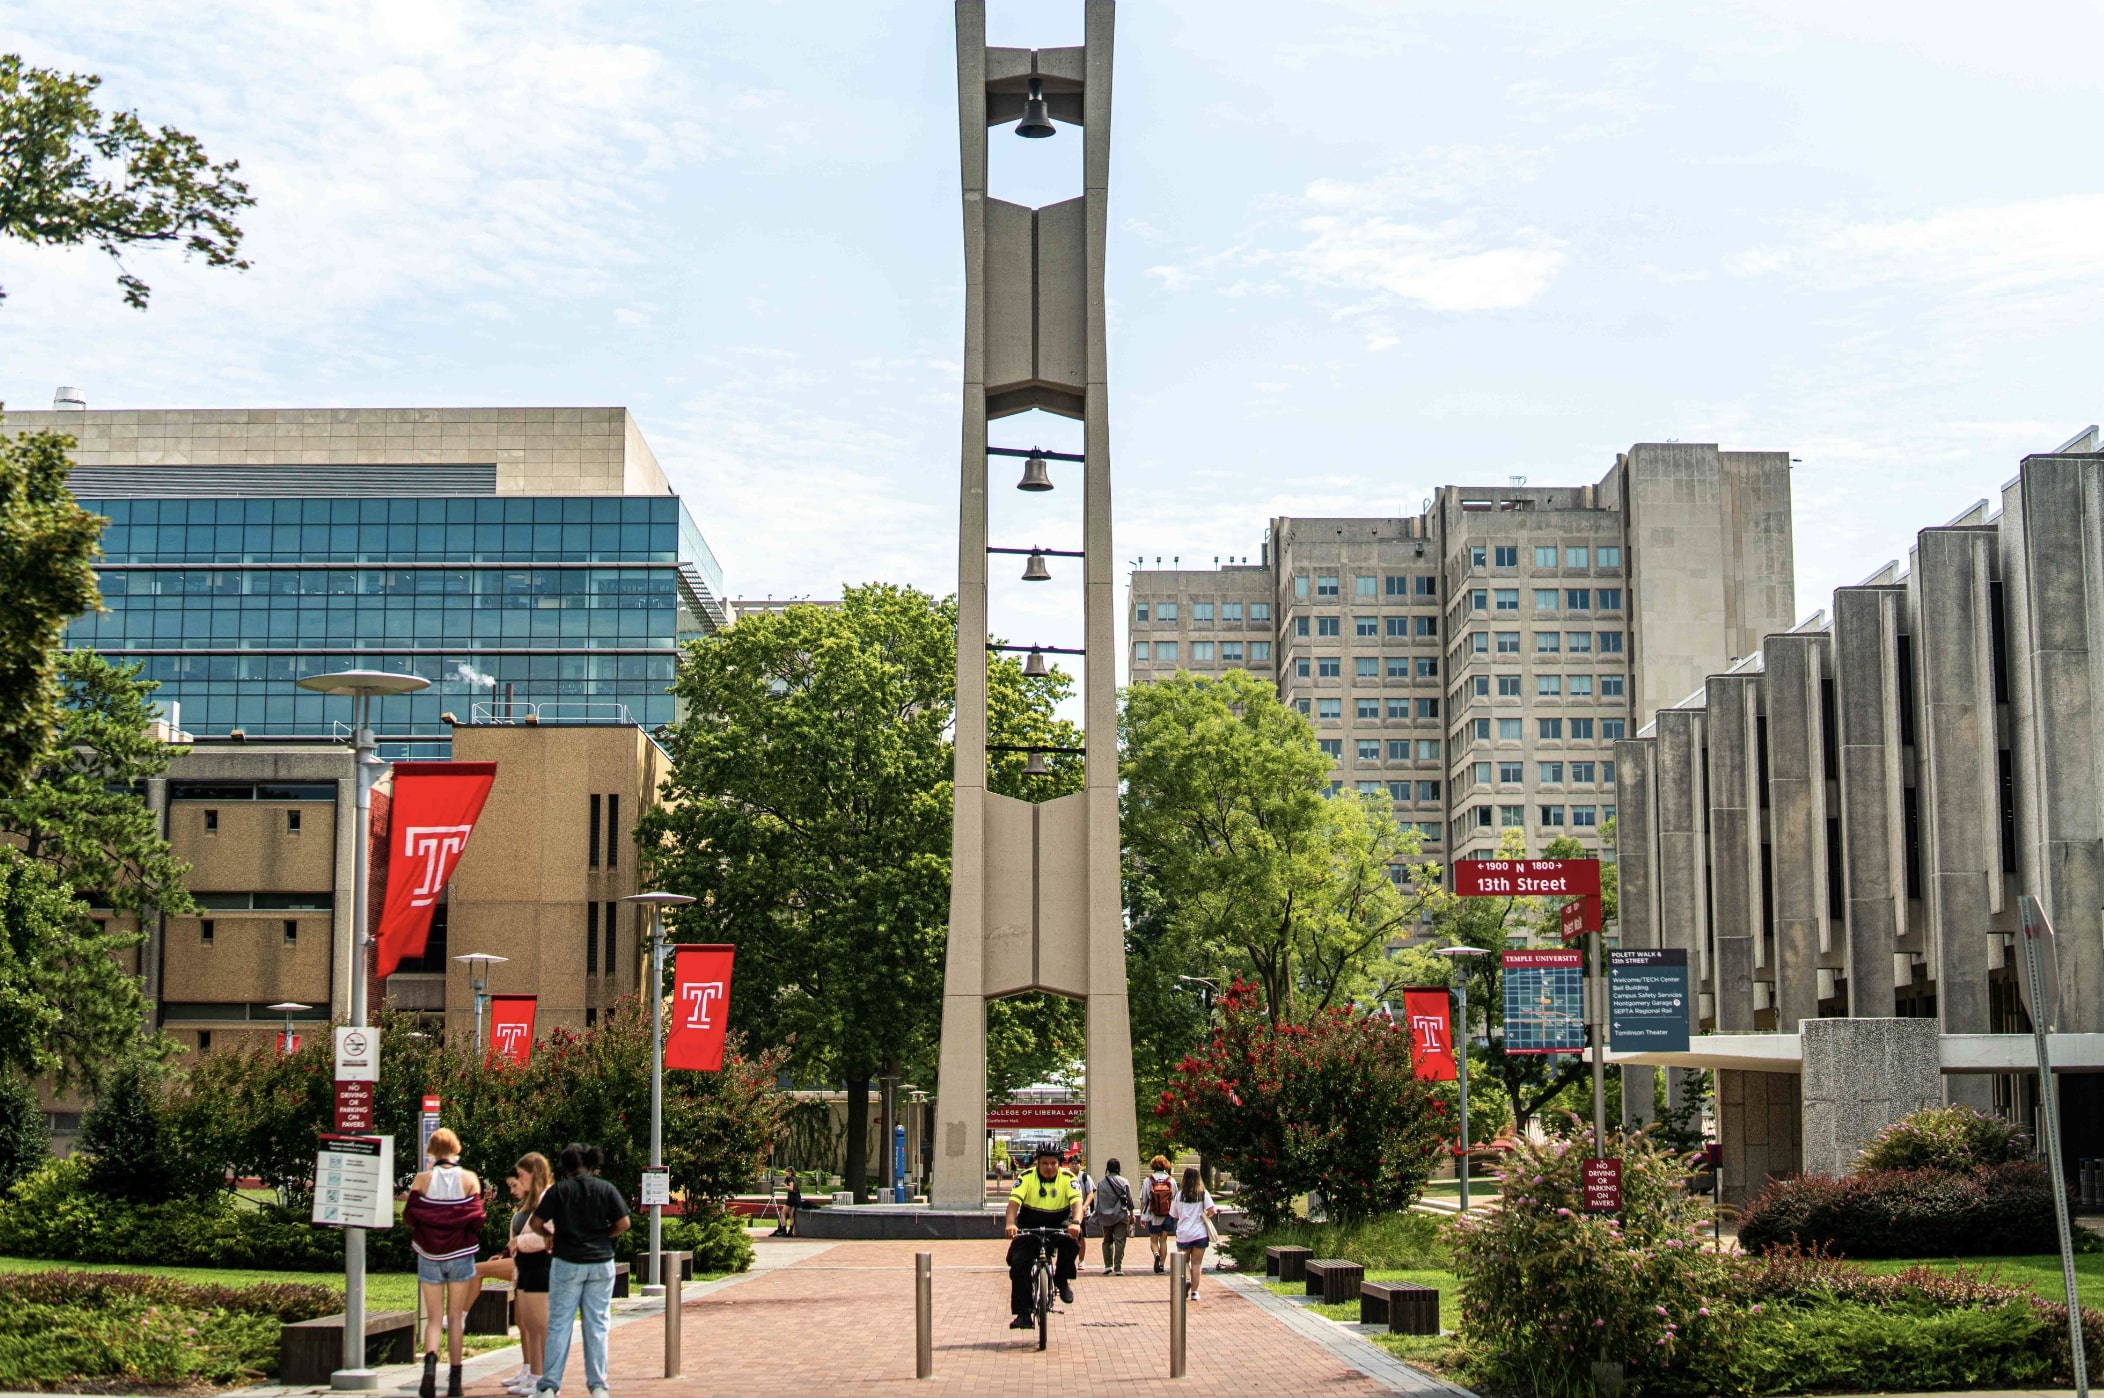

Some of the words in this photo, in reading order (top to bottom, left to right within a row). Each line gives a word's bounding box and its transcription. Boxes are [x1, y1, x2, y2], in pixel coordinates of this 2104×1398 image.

[1486, 862, 1509, 870] 1900
[1516, 863, 1524, 873] N
[1532, 862, 1554, 870] 1800
[1477, 878, 1510, 891] 13th
[1517, 877, 1566, 891] Street
